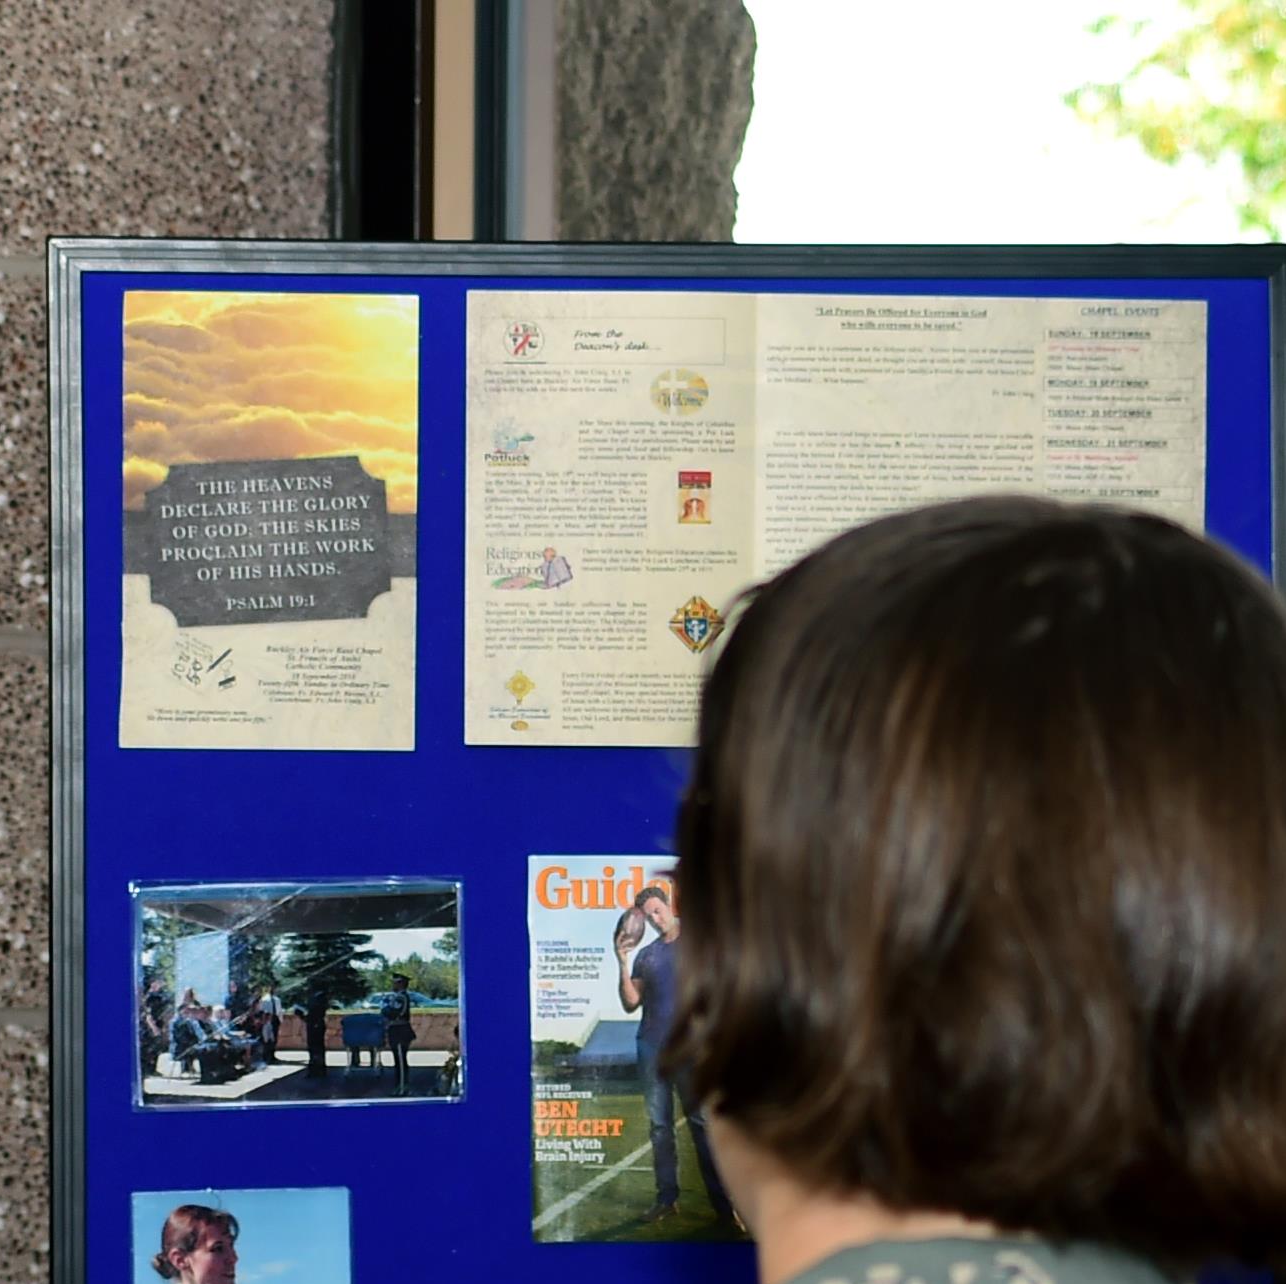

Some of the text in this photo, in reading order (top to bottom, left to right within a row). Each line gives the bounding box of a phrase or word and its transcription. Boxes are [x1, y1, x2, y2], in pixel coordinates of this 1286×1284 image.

[575, 329, 623, 338] From the
[484, 453, 530, 462] Potluck
[196, 476, 333, 496] THE HEAVENS
[161, 495, 371, 518] DECLARE THE GLORY
[173, 525, 198, 539] OF
[259, 521, 300, 536] THE
[305, 518, 362, 533] SKIES
[162, 538, 375, 562] PROCLAIM THE WORK
[486, 546, 543, 563] Religious
[197, 562, 341, 581] OF HIS HANDS.
[486, 563, 544, 578] Education
[227, 595, 315, 611] PSALM 19:1
[534, 1101, 579, 1118] BEN
[534, 1119, 623, 1136] UTECHT
[535, 1139, 602, 1152] Living With
[535, 1150, 605, 1164] Brain Injury
